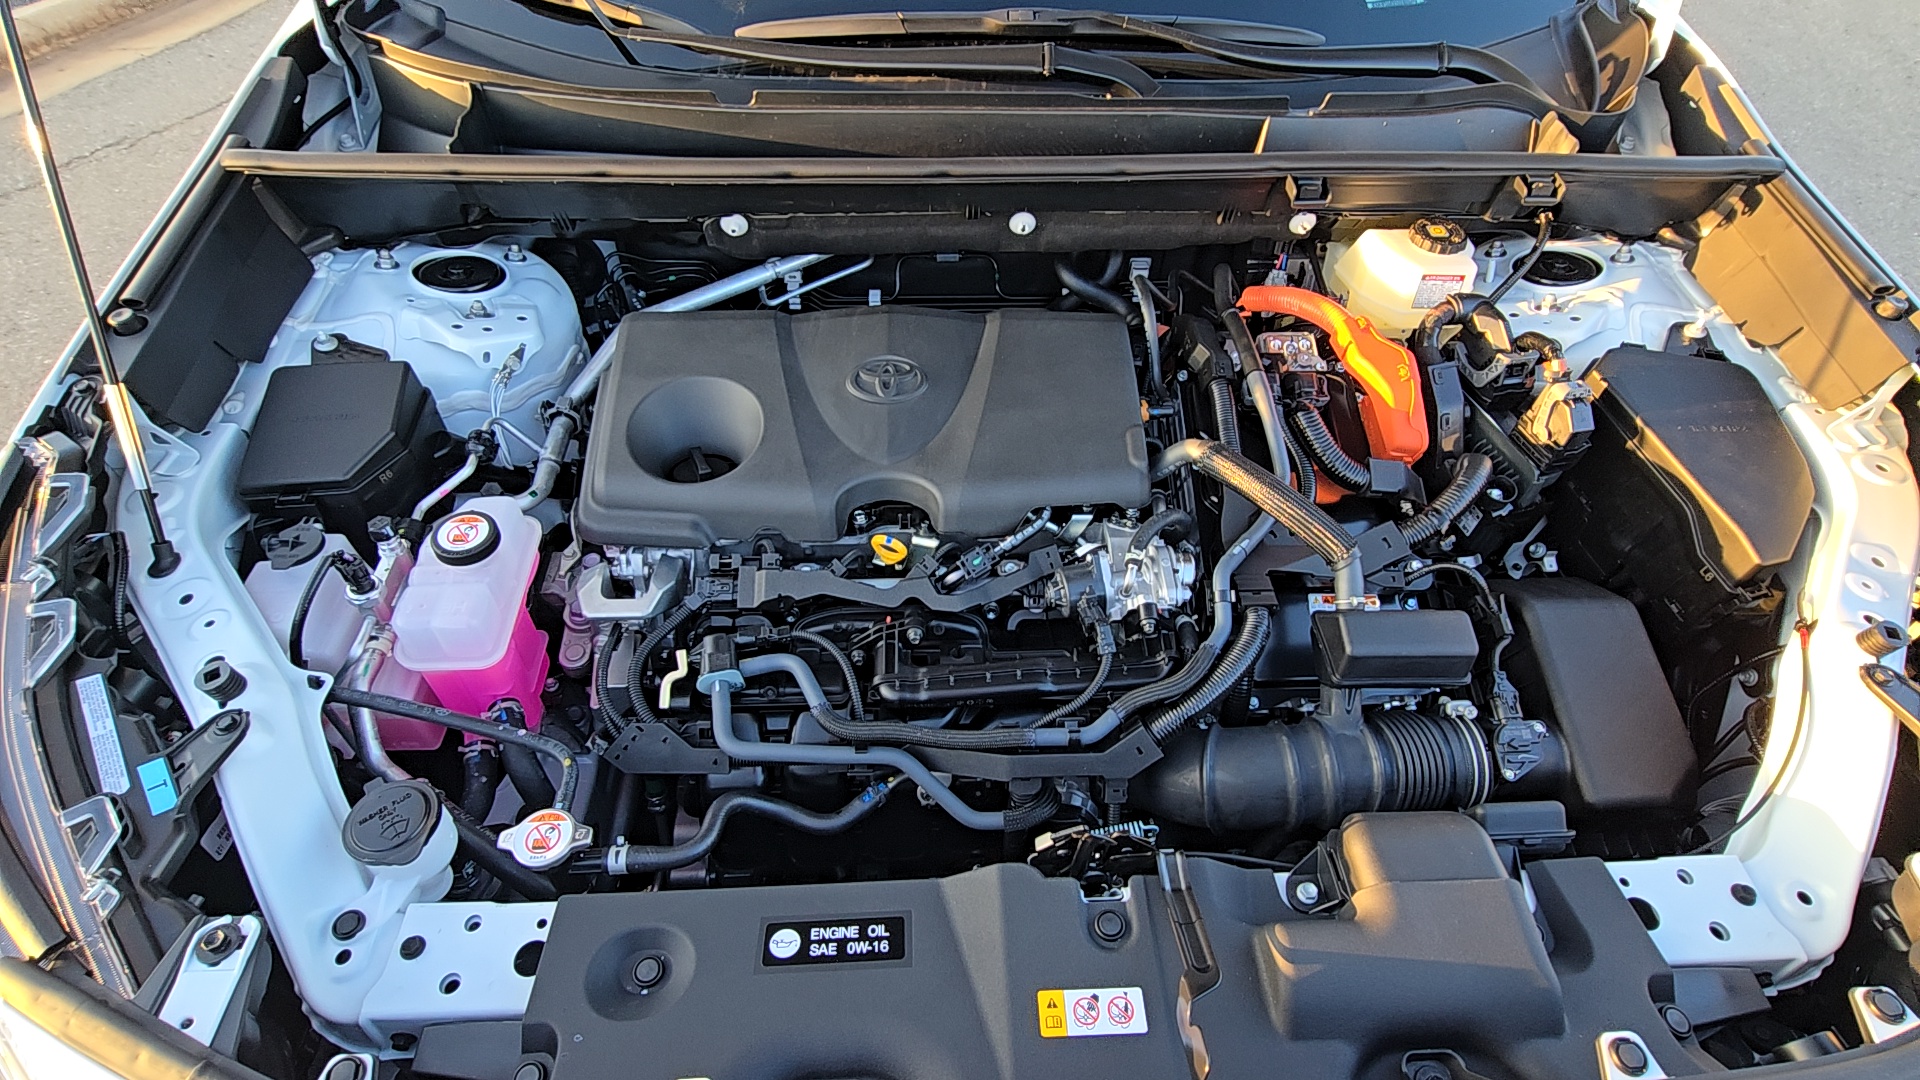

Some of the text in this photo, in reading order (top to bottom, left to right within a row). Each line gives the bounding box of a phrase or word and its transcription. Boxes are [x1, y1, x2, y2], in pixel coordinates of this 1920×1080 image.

[810, 924, 890, 940] ENGINE OIL
[809, 940, 889, 956] SAE 0W-16
